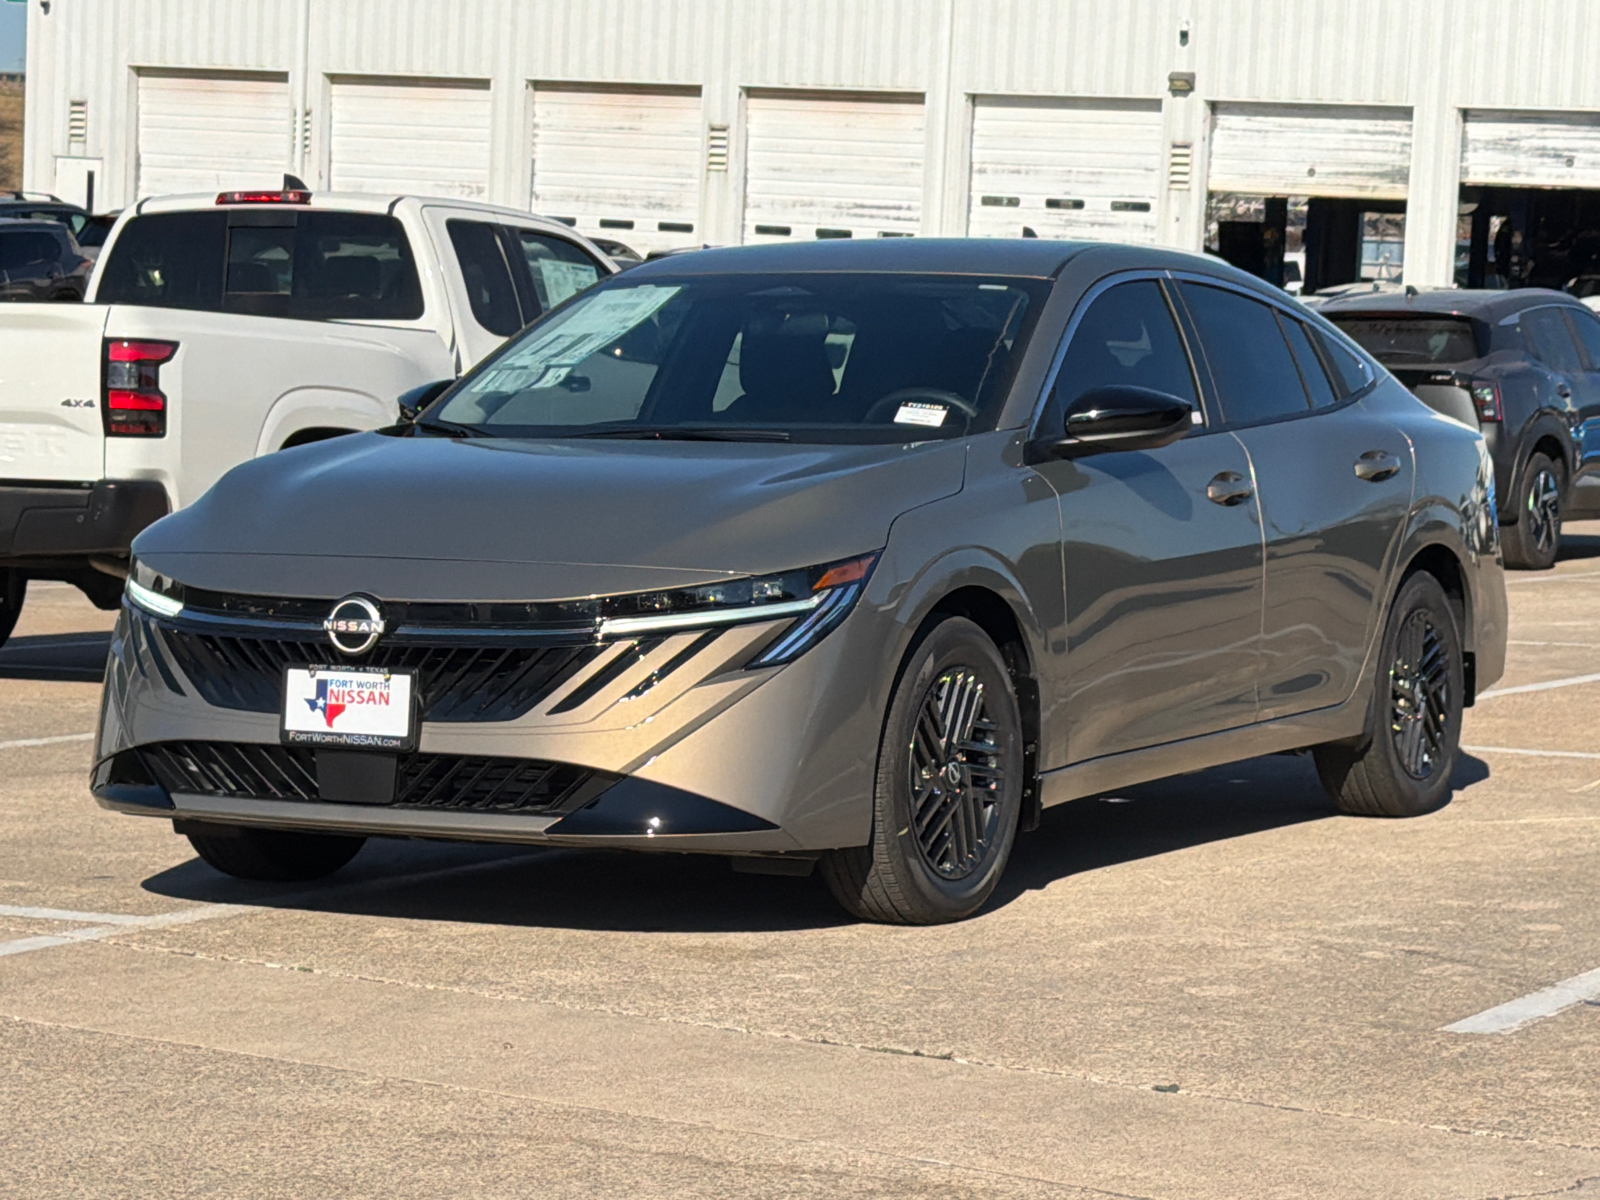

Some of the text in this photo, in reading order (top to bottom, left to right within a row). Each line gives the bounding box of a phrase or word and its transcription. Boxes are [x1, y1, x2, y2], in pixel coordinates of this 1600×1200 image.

[323, 619, 385, 633] NISSAN
[309, 663, 389, 674] FORT WORTH TEXAS
[329, 678, 390, 691] FORT WORTH
[328, 689, 390, 706] NISSAN
